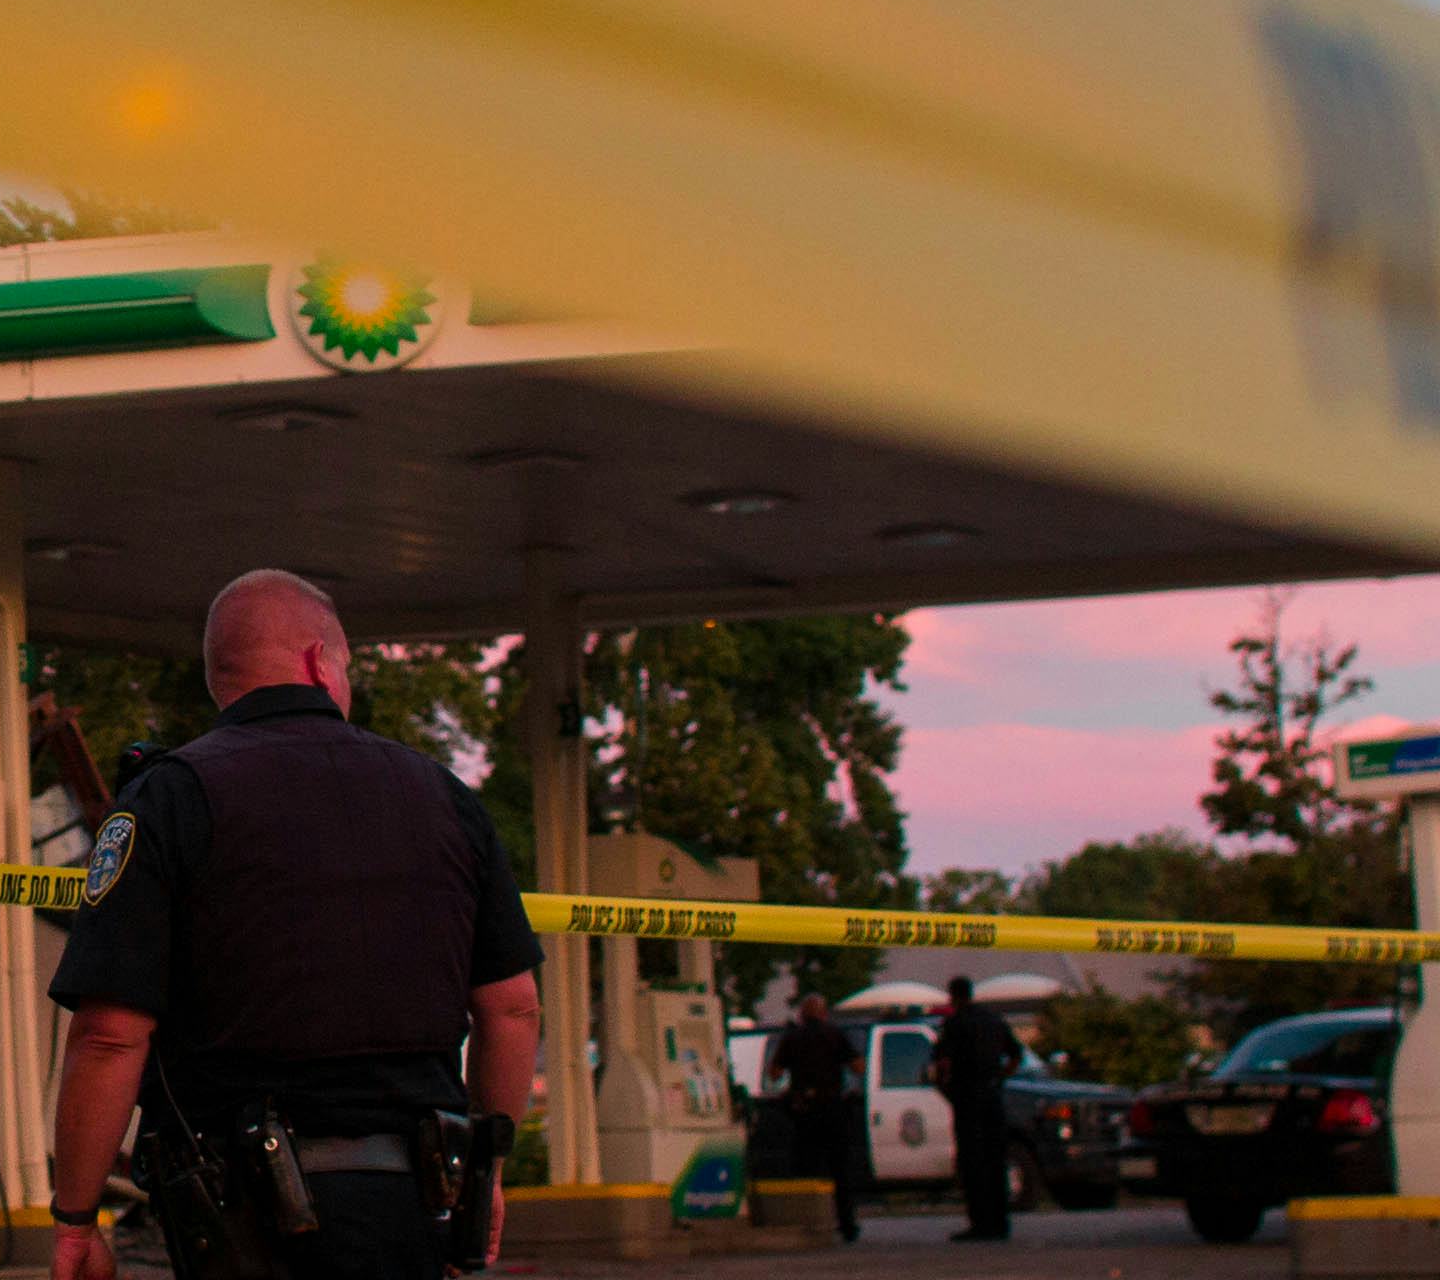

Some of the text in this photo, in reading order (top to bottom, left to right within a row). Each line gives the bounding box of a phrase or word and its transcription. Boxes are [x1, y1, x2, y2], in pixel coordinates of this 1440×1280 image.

[28, 875, 50, 905] DO
[51, 876, 85, 908] NOT
[568, 904, 737, 938] POLICE LINE DO NOT CROSS
